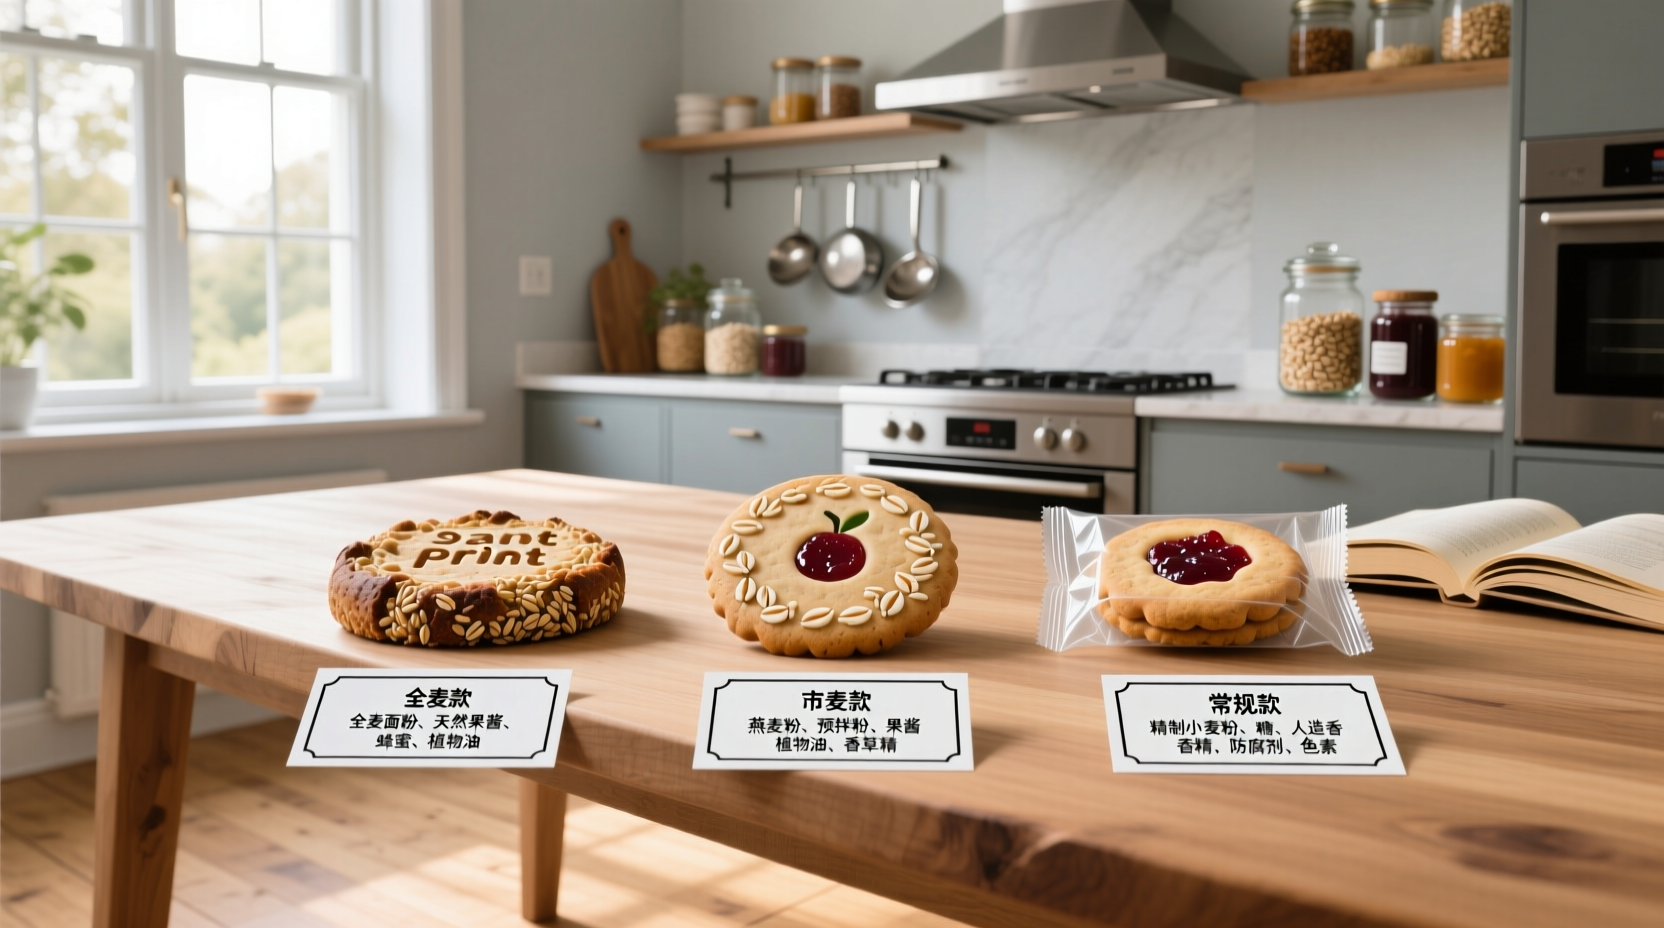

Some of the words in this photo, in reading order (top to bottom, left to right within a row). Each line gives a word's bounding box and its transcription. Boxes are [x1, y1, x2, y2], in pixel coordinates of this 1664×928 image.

[404, 687, 473, 709] 全麦款
[801, 690, 872, 712] 市麦款
[1208, 693, 1282, 716] 常规款
